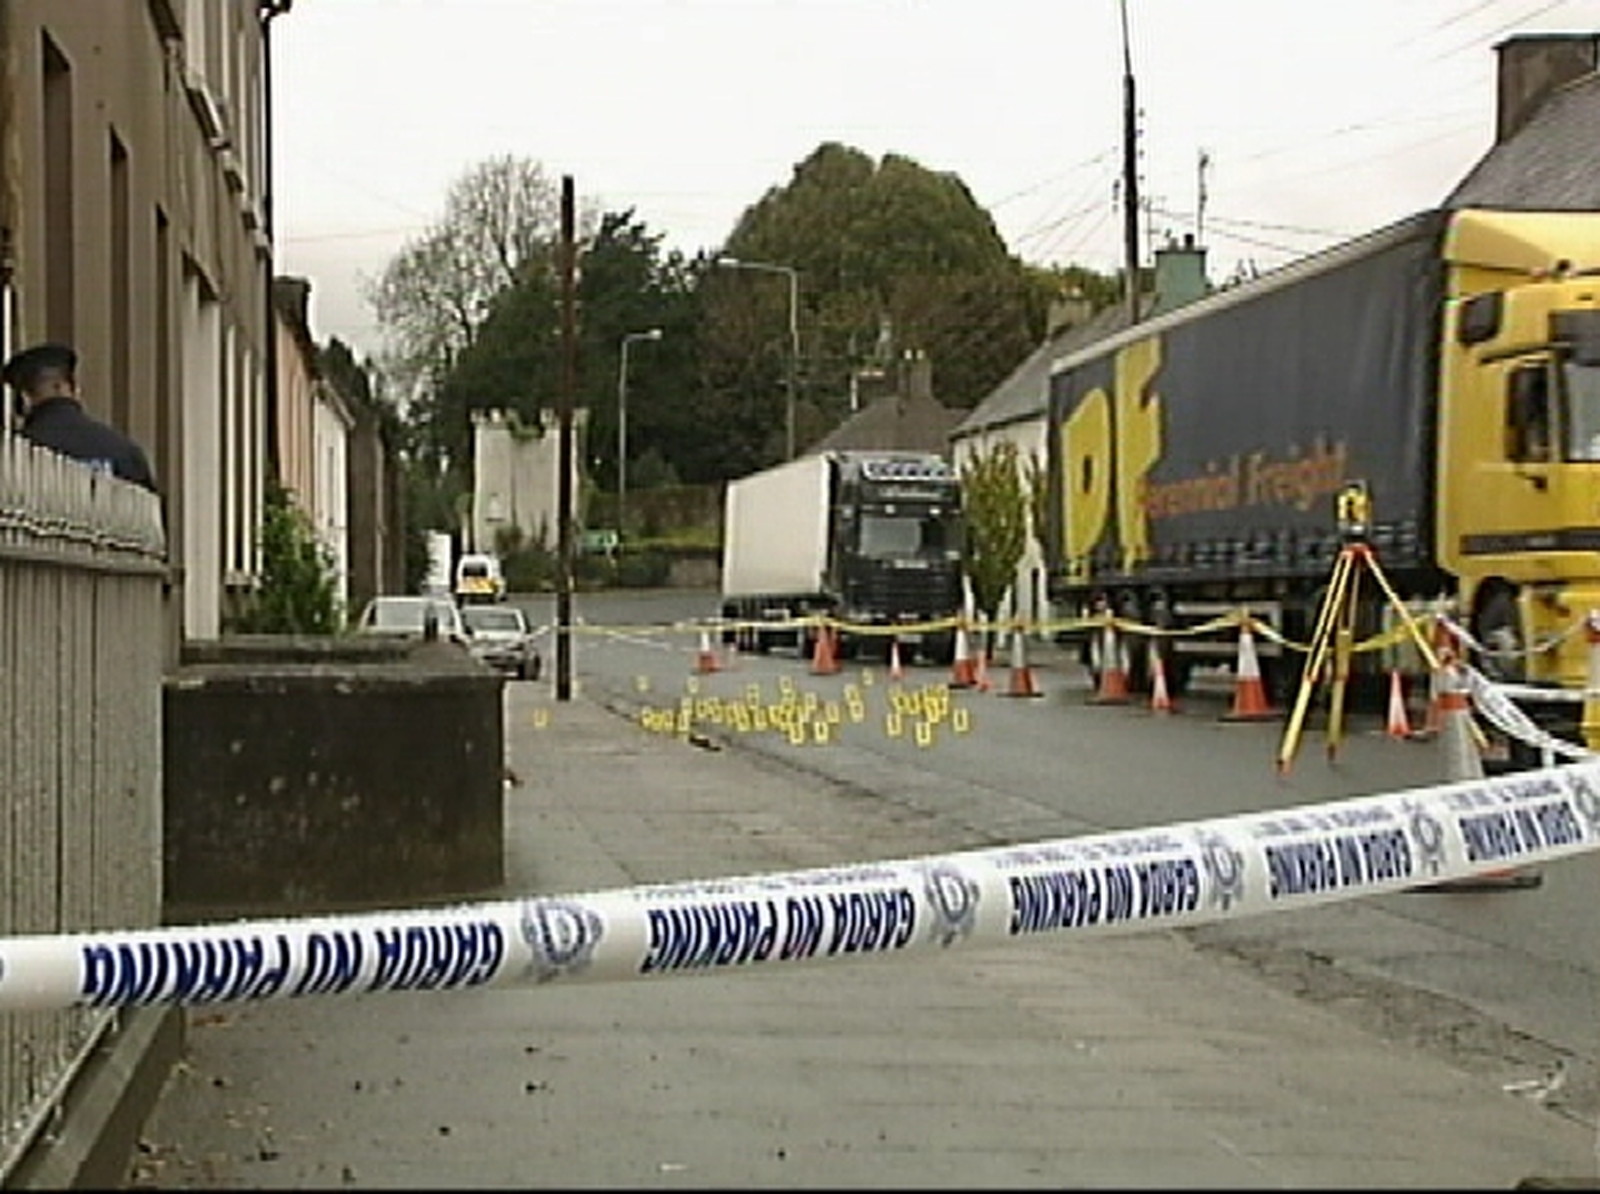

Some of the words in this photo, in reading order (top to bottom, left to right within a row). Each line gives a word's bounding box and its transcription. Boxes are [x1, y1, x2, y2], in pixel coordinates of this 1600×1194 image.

[1266, 839, 1336, 899] PARKING
[1336, 835, 1362, 886] NO
[1358, 830, 1412, 883] GARDA
[1009, 869, 1101, 935] PARKING
[1105, 865, 1134, 924] NO
[1135, 860, 1199, 919] GARDA
[639, 901, 778, 974] PARKING
[780, 896, 823, 960] NO
[827, 889, 915, 956] GARDA
[82, 936, 290, 1006] PARKING
[294, 930, 362, 997] NO
[373, 923, 504, 989] GARDA
